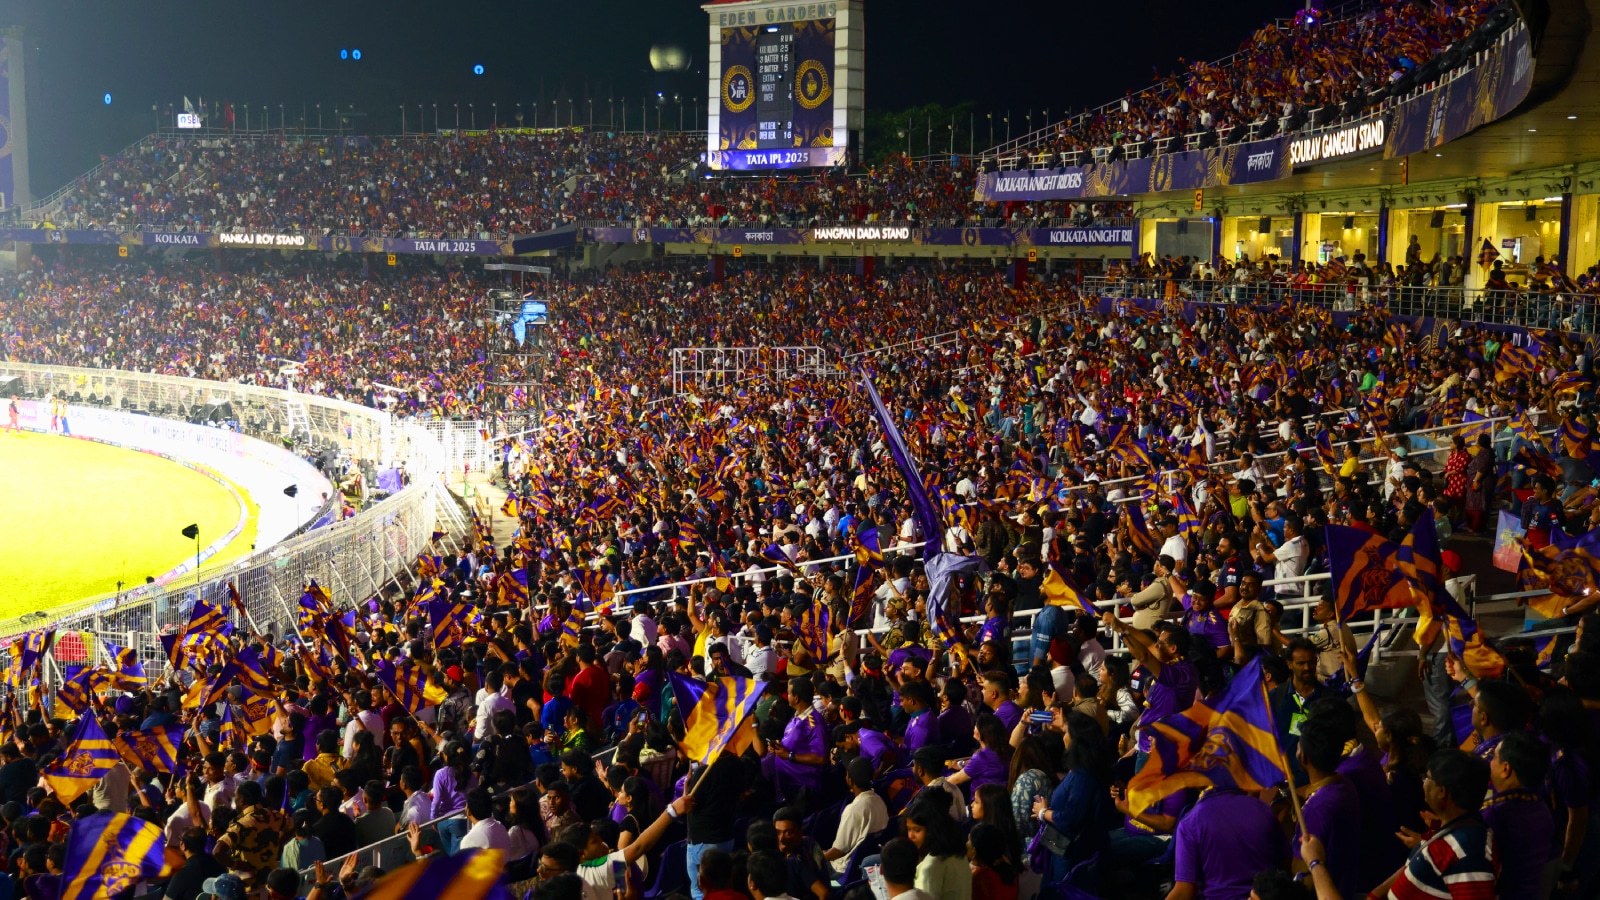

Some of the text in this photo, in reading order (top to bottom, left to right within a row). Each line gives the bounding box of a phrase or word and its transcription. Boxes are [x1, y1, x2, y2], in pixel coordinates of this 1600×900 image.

[720, 3, 837, 26] EDEN GARDENS
[780, 34, 793, 42] RUN
[780, 44, 789, 52] 25
[759, 55, 764, 63] 3
[781, 54, 789, 62] 16
[759, 65, 764, 73] 2
[788, 92, 792, 100] 4
[787, 121, 792, 129] 9
[783, 131, 792, 139] 16
[1290, 119, 1384, 164] SOURAV GANGULY STAND
[746, 152, 809, 165] TATA IPL 2025
[1247, 150, 1274, 171] কলকাতা
[996, 172, 1083, 192] KOLKATA KNIGHT RIDERS
[155, 233, 199, 245] KOLKATA
[219, 233, 305, 246] PANKAJ ROY STAND
[745, 231, 774, 242] কলকাতা
[814, 228, 909, 240] HANGPAN DADA STAND
[1050, 231, 1087, 243] KOLKATA
[1088, 230, 1121, 243] KNIGHT
[414, 241, 476, 252] TATA IPL 2025
